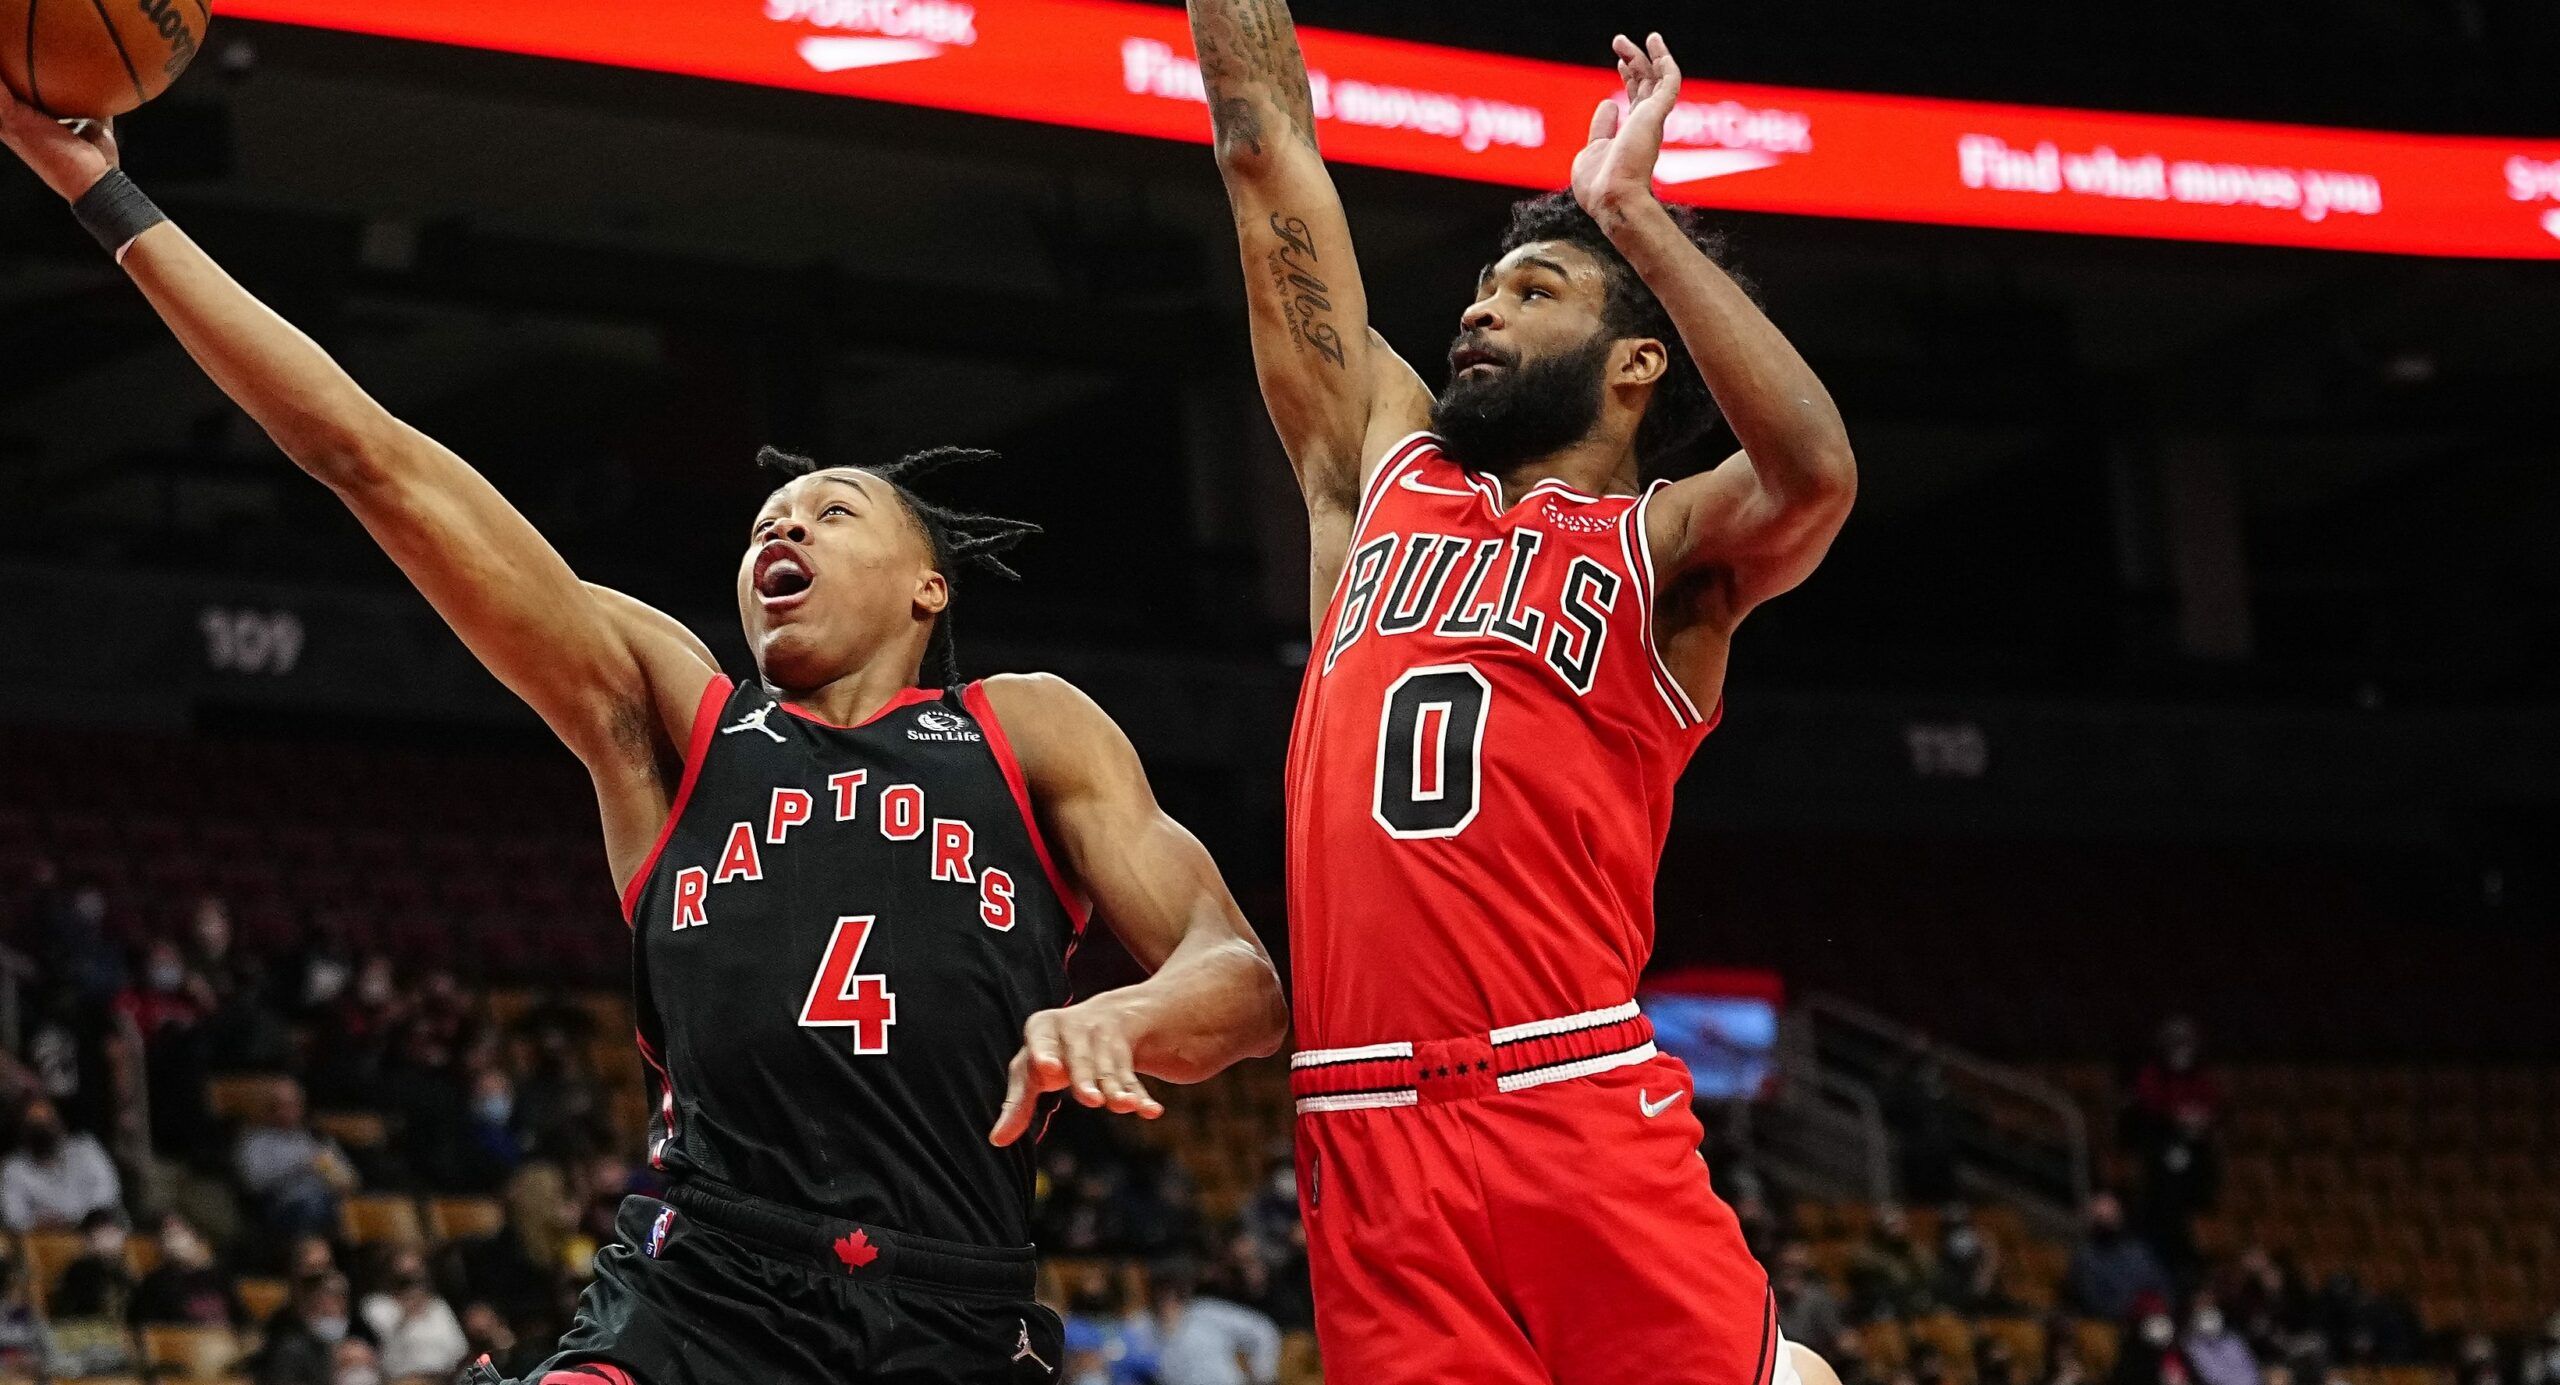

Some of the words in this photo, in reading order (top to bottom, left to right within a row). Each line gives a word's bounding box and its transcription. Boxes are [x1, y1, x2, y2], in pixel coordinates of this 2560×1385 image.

[1122, 36, 1208, 103] Fin
[1333, 80, 1463, 137] moves
[1461, 97, 1545, 153] you
[1957, 133, 2062, 193] Find
[2062, 145, 2169, 200] what
[2168, 161, 2303, 209] moves
[2302, 169, 2383, 222] you
[200, 606, 303, 675] 109
[1322, 524, 1622, 698] BULLS
[907, 729, 943, 742] Sun
[946, 731, 981, 742] Life
[1371, 662, 1493, 840] 0
[672, 768, 1016, 932] RAPTORS
[798, 915, 897, 1056] 4
